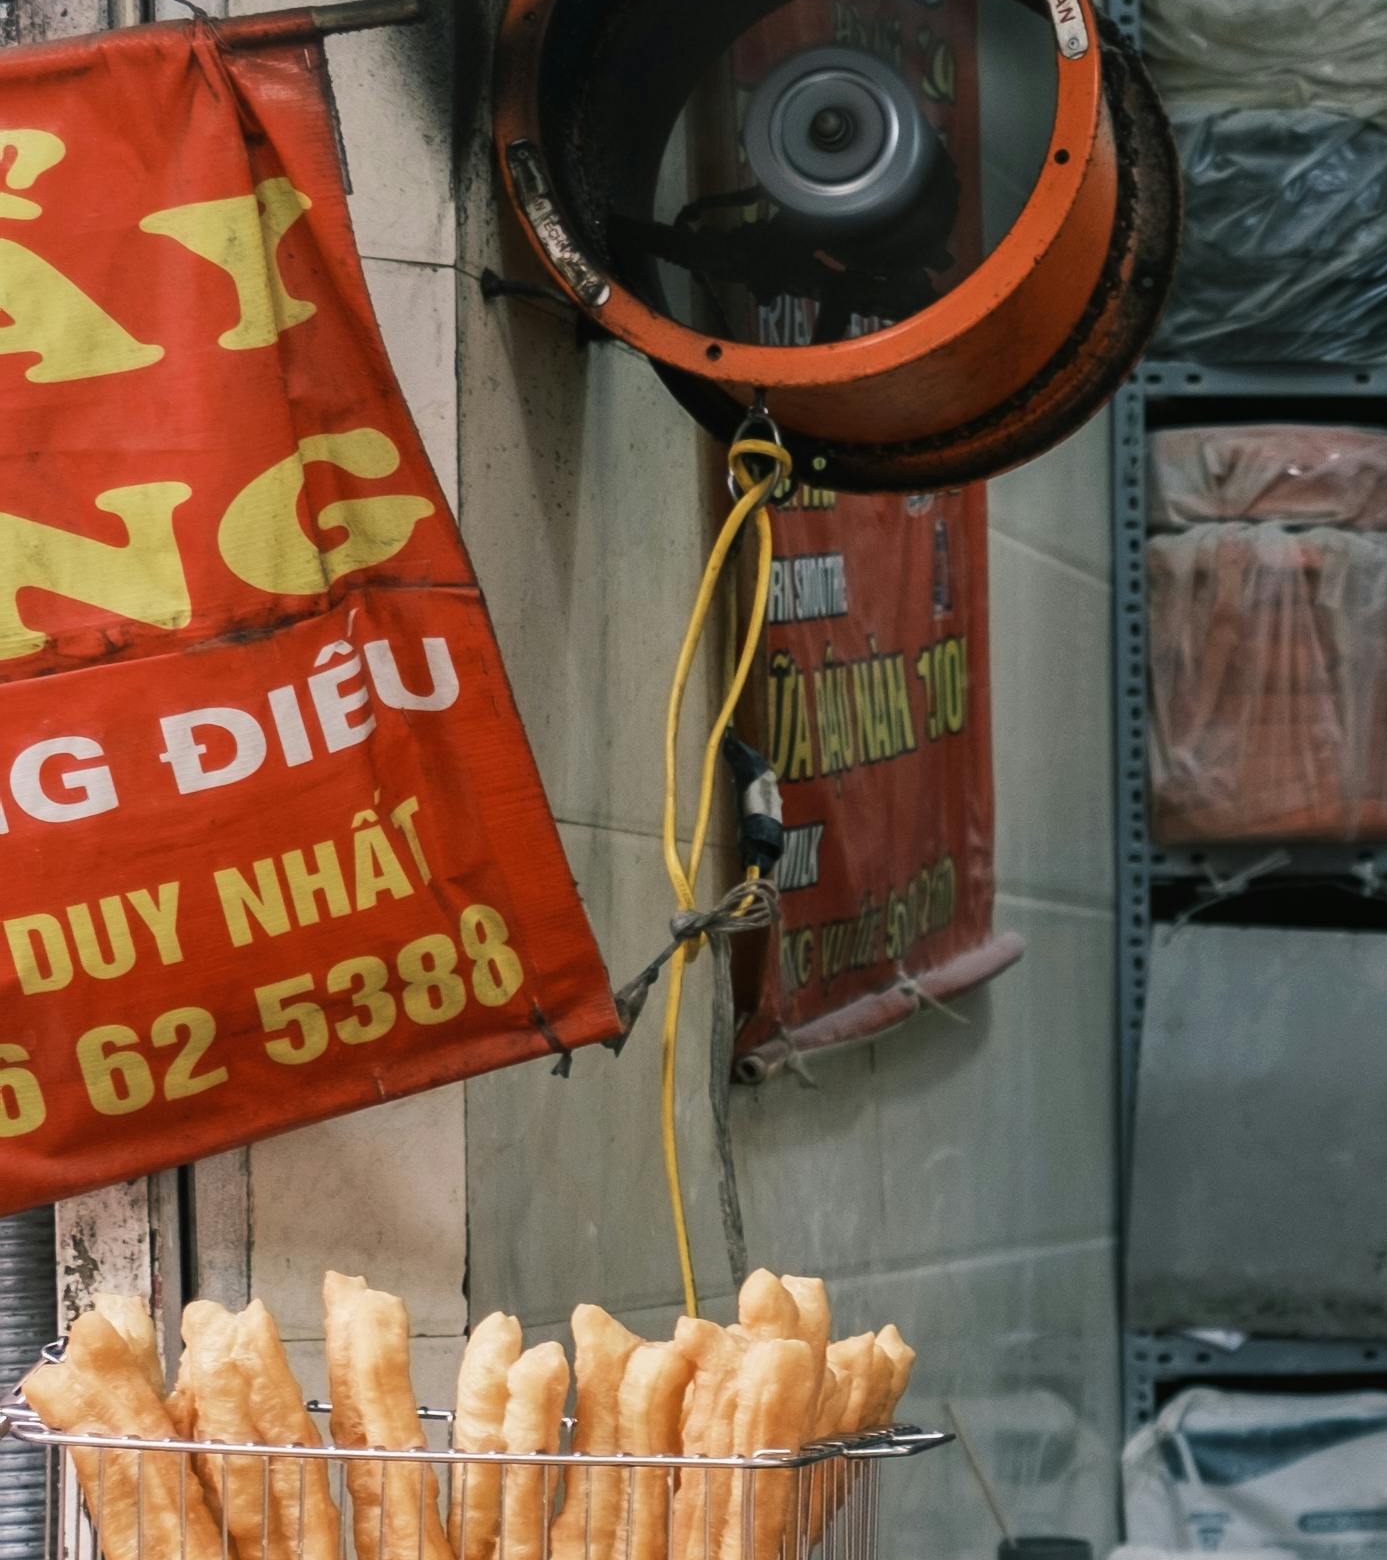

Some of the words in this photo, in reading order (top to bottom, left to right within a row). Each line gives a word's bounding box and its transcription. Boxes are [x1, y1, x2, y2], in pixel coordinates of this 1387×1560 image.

[159, 607, 460, 796] ĐIẾU
[3, 882, 184, 997] DUY
[213, 787, 433, 948] NHẤT
[75, 1005, 230, 1117] 62
[253, 903, 526, 1066] 5388
